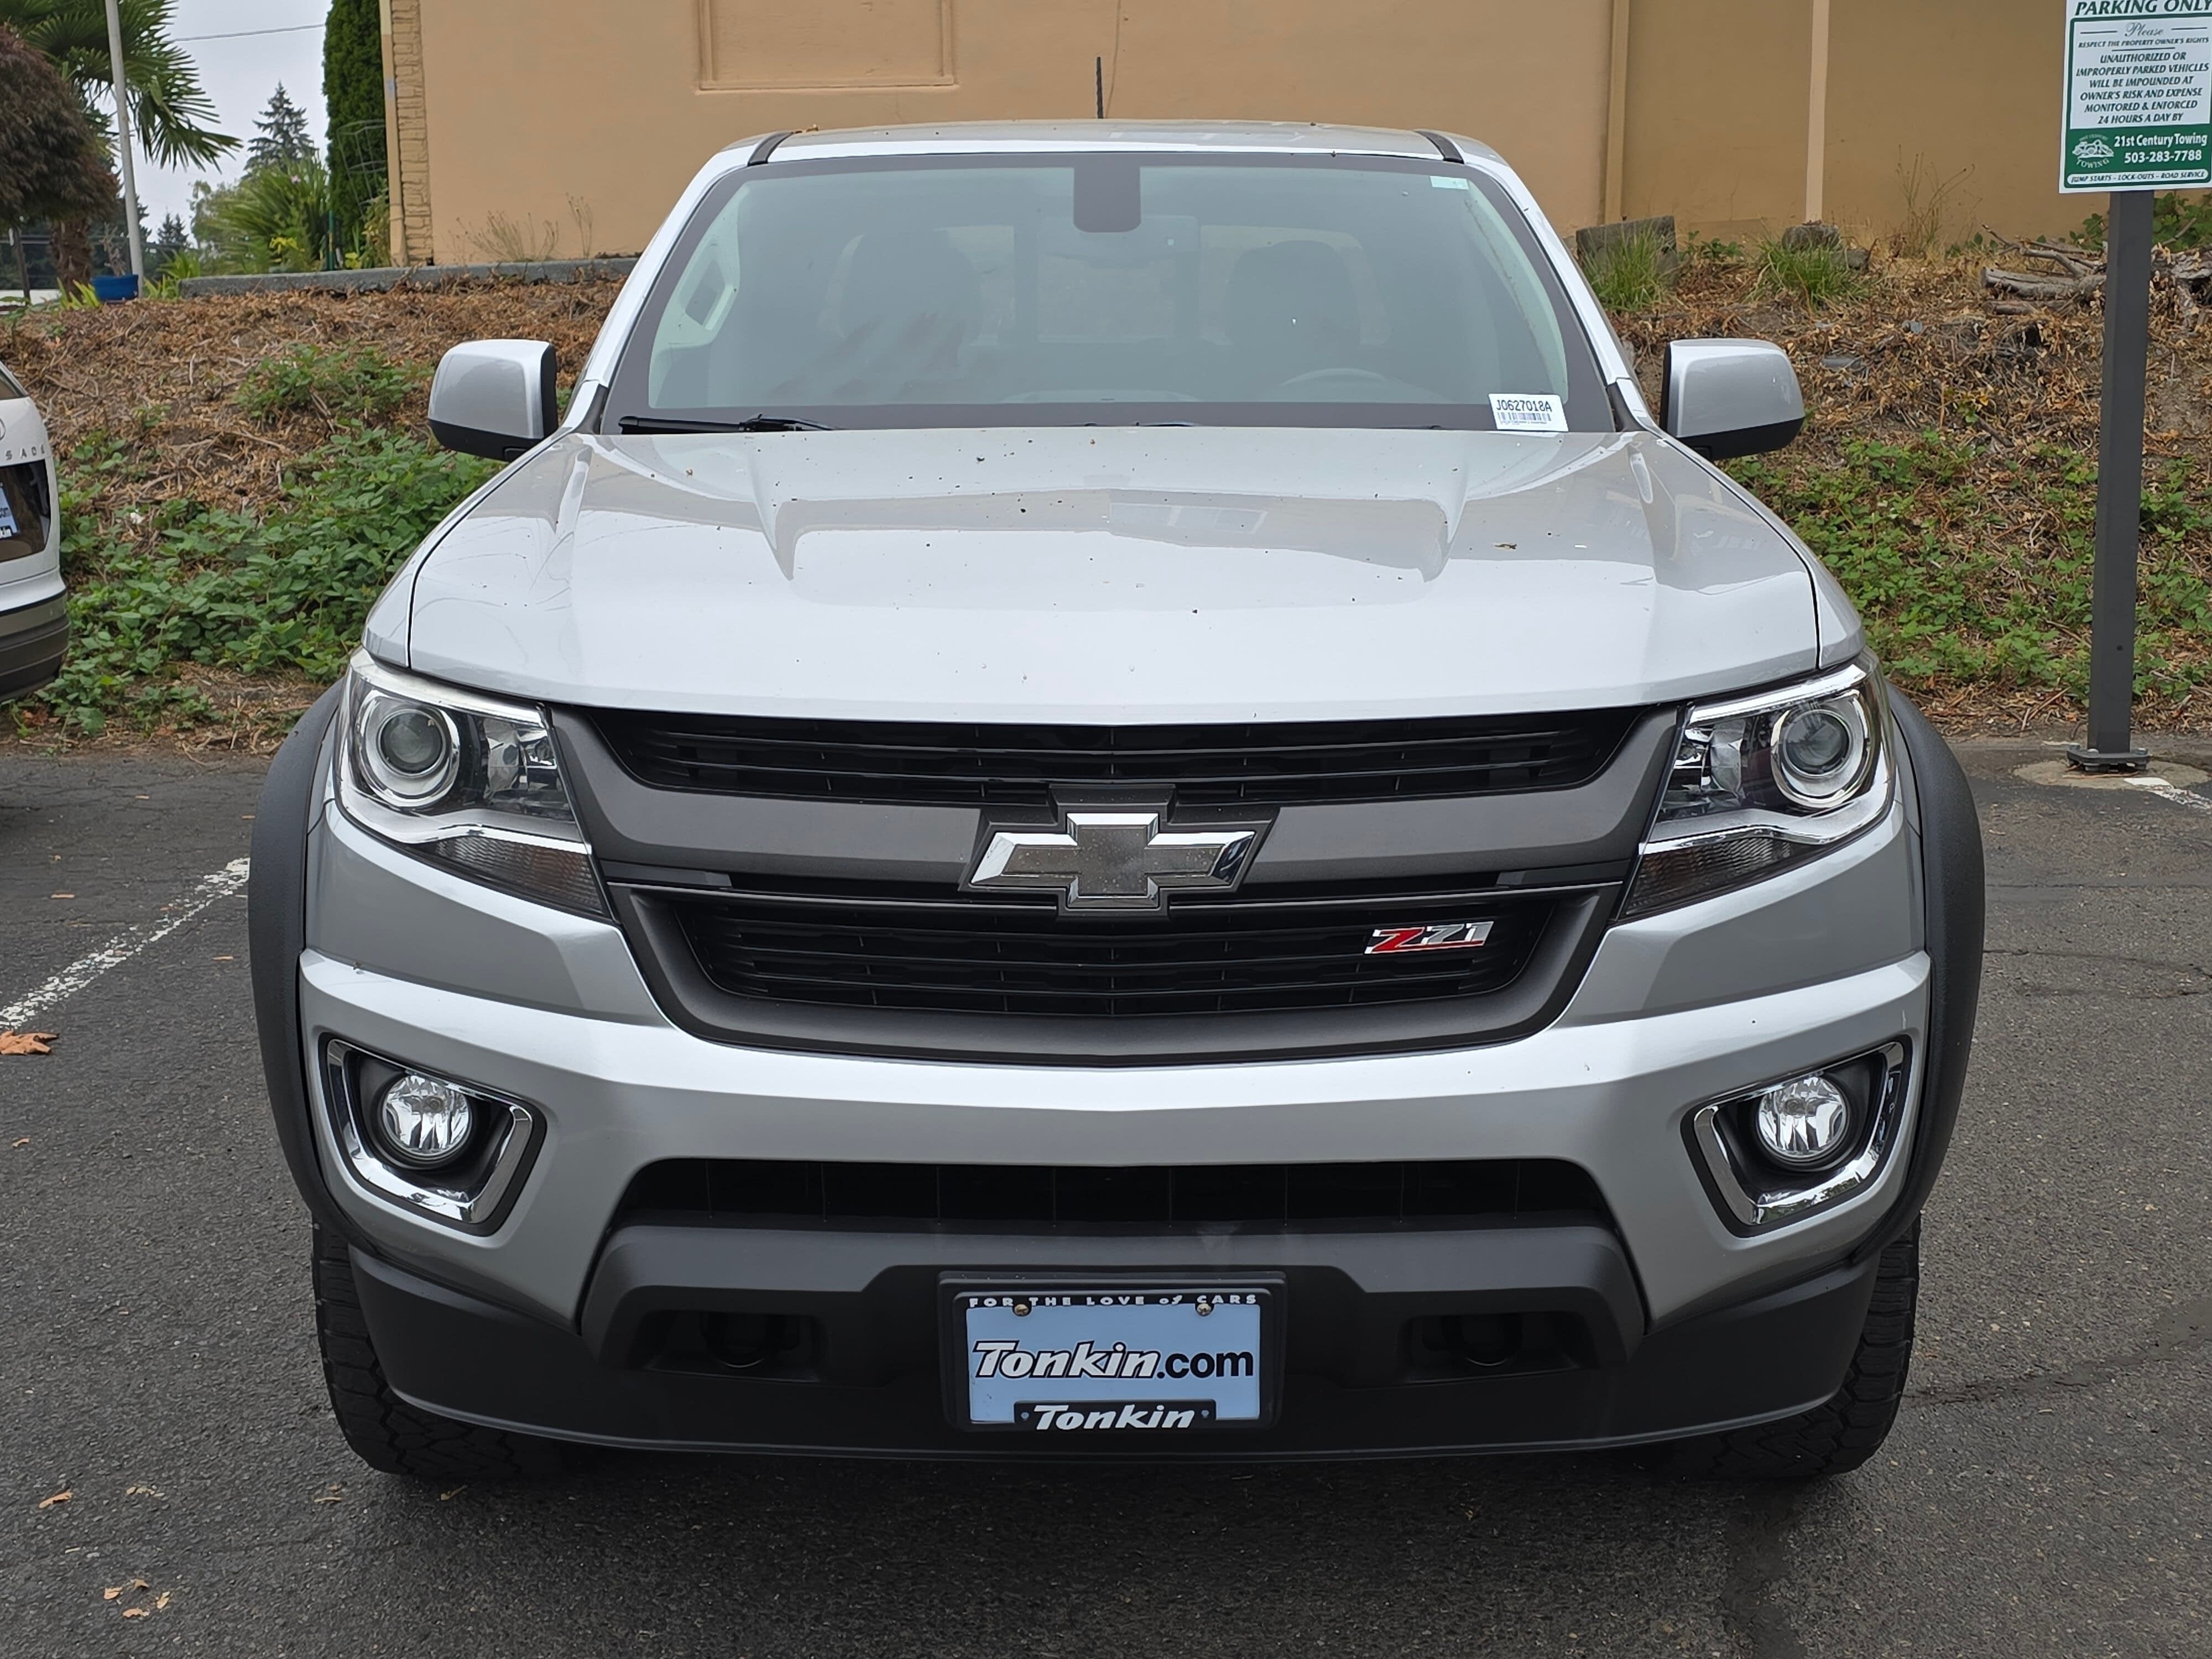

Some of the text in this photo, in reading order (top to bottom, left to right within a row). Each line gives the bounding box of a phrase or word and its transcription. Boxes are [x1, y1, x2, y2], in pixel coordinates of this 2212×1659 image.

[2075, 0, 2212, 15] PARKING ONLY
[2124, 22, 2163, 36] Please
[2100, 52, 2186, 63] UNAUTHORIZED OR
[2076, 63, 2209, 76] IMPROPERLY PARKED VEHICLES
[2089, 79, 2110, 88] WILL
[2125, 77, 2180, 86] IMPOUNDED
[2182, 76, 2194, 84] AT
[2080, 88, 2203, 101] OWNER'S RISK AND EXPENSE
[2084, 101, 2198, 113] MONITORED & ENFORCED
[2098, 113, 2183, 124] 24 HOURS A DAY BY
[2114, 136, 2135, 147] 21st
[2136, 134, 2173, 148] Century
[2174, 132, 2208, 147] Towing
[2124, 150, 2202, 163] 503-283-7788
[1496, 400, 1552, 412] J0627018A
[1364, 921, 1494, 954] Z71
[969, 1297, 1013, 1308] FOR
[1029, 1297, 1071, 1306] THE
[1086, 1296, 1144, 1306] LOVE
[1197, 1295, 1256, 1305] CARS
[972, 1340, 1254, 1379] Tonkin.com
[1034, 1404, 1195, 1430] Tonkin
